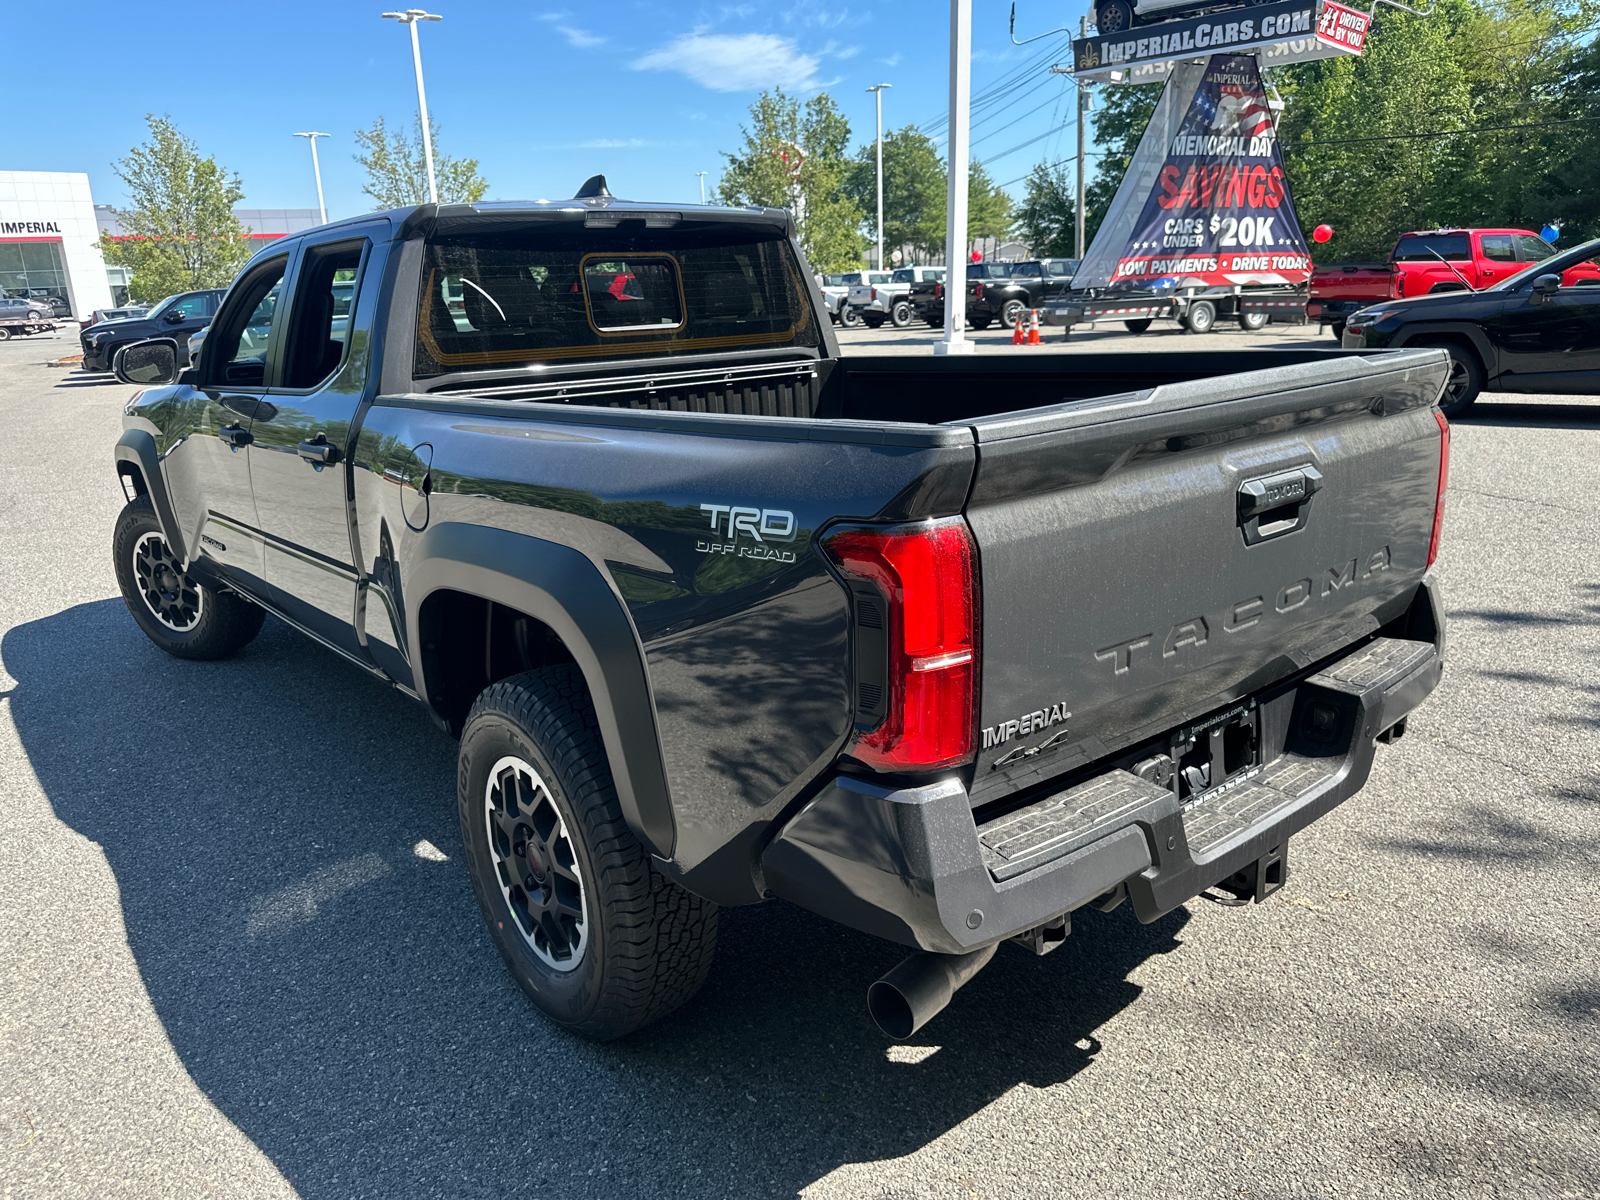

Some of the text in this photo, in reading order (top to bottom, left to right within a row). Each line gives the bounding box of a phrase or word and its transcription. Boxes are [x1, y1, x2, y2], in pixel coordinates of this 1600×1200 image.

[1319, 7, 1340, 37] #1
[1338, 11, 1367, 33] DRIVEN
[1335, 26, 1363, 47] BY YOU
[1213, 73, 1251, 85] IMPERIAL
[1171, 136, 1246, 157] MEMORIAL
[1249, 136, 1276, 157] DAY
[1158, 165, 1285, 209] SAVINGS
[1, 222, 61, 234] IMPERIAL
[1164, 218, 1204, 235] CARS
[1209, 214, 1275, 247] $20K
[1163, 235, 1204, 248] UNDER
[1117, 260, 1148, 277] LOW
[1150, 257, 1218, 275] PAYMENTS
[1231, 256, 1270, 271] DRIVE
[1272, 256, 1309, 270] TODAY
[1267, 481, 1304, 502] TOYOTA
[700, 503, 798, 542] TRD
[695, 540, 797, 563] OFF ROAD
[1094, 545, 1391, 675] TACOMA
[982, 701, 1073, 749] IMPERIAL
[1191, 705, 1244, 734] Imperialcars.com
